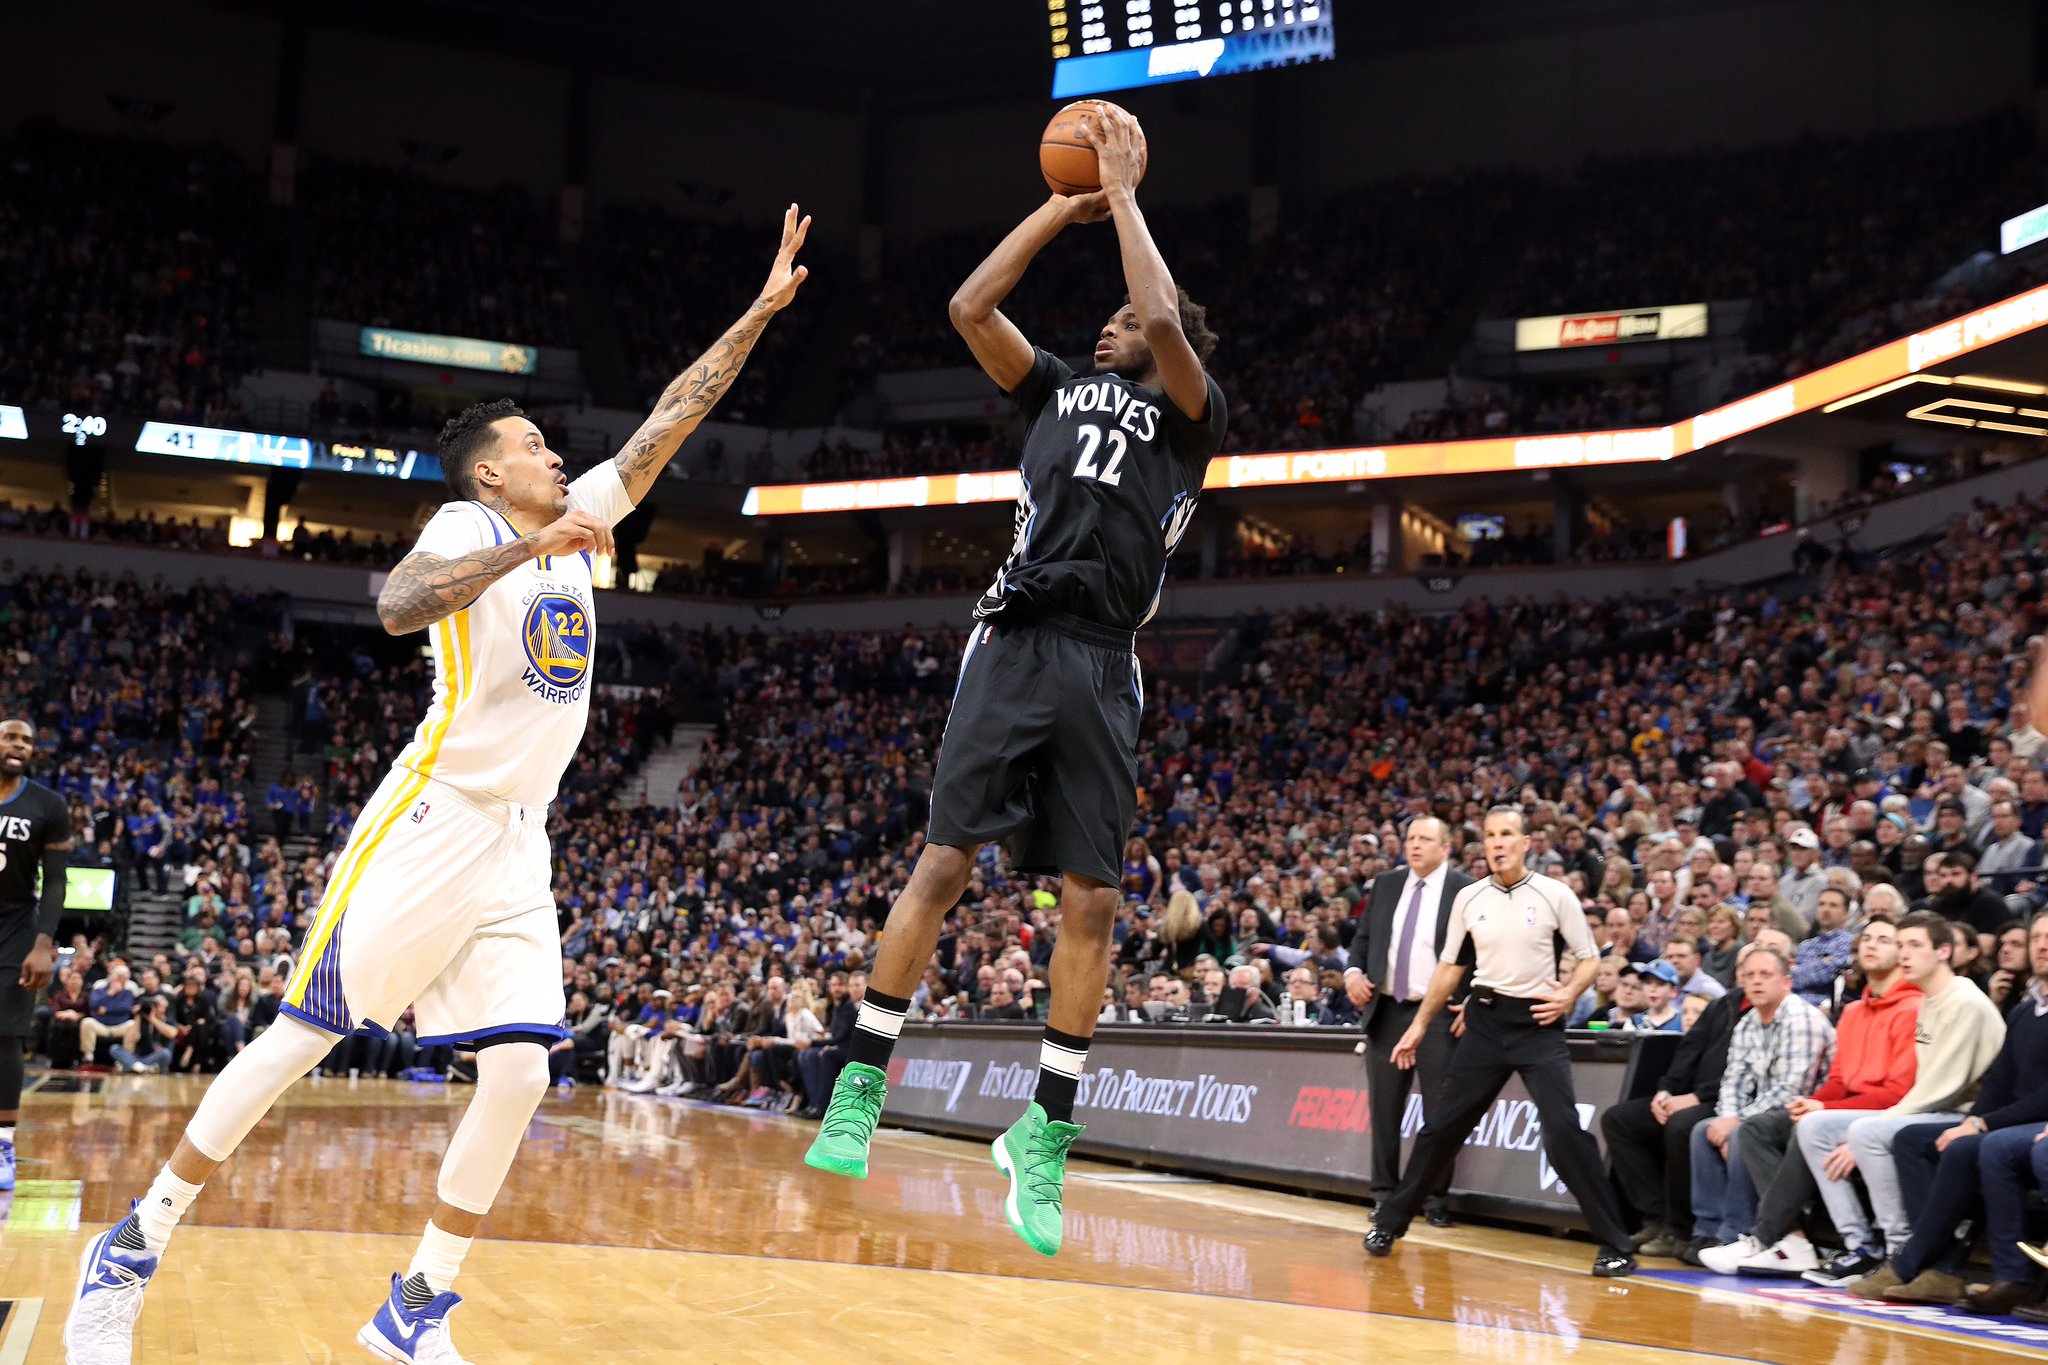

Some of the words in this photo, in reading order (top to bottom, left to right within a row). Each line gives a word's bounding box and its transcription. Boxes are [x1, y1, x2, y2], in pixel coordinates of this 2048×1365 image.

[1055, 382, 1161, 442] WOLVES
[166, 432, 194, 449] 41
[1072, 424, 1128, 487] 22
[555, 612, 585, 637] 22
[520, 666, 588, 705] WARRIOR
